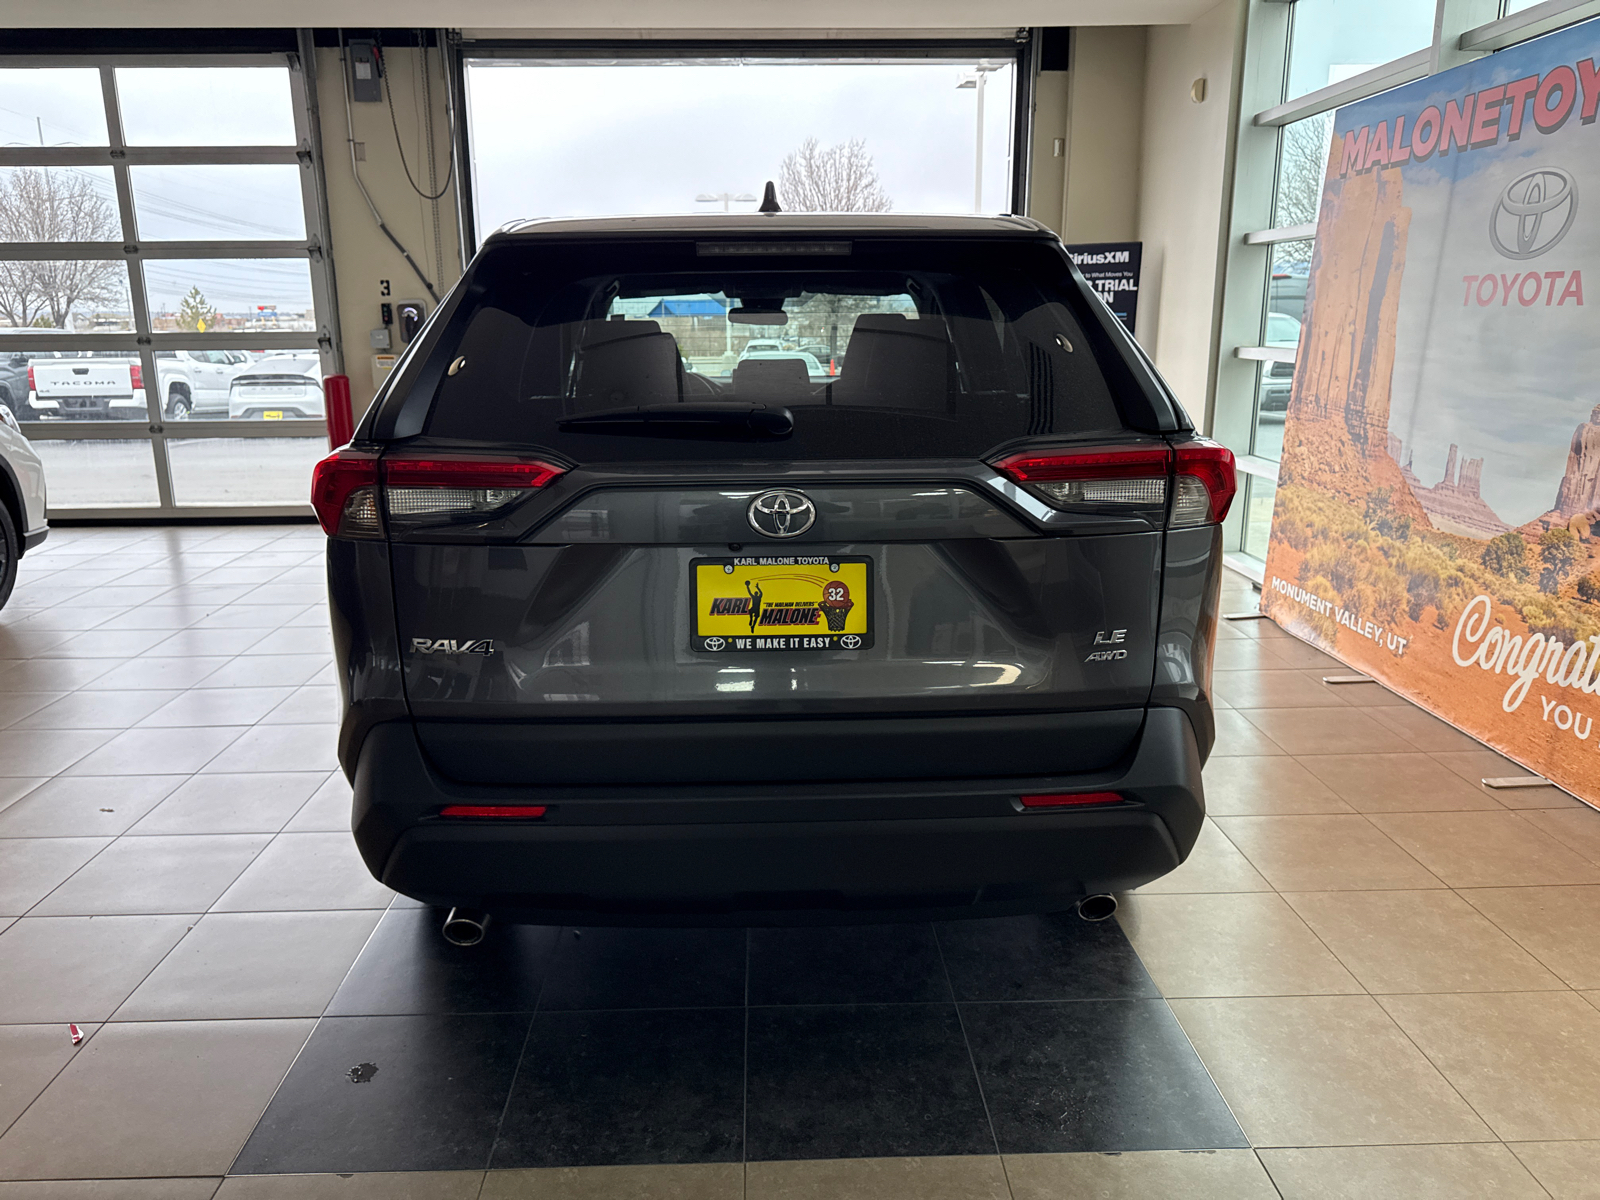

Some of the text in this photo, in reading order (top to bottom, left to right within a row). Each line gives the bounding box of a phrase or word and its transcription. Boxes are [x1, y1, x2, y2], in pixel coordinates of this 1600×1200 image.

[380, 280, 391, 296] 3
[1095, 279, 1138, 291] TRIAL
[1462, 270, 1584, 307] TOYOTA
[734, 556, 830, 566] KARL MALONE TOYOTA
[828, 587, 844, 601] 32
[709, 597, 751, 616] KARL
[758, 607, 821, 626] MALONE
[1271, 576, 1407, 655] MONUMENT VALLEY, UT
[736, 637, 831, 649] WE MAKE IT EASY
[1093, 629, 1127, 645] LE
[409, 638, 494, 656] RAV4
[1084, 649, 1128, 662] AWD
[1452, 595, 1600, 713] Congrat
[1541, 695, 1593, 740] YOU
